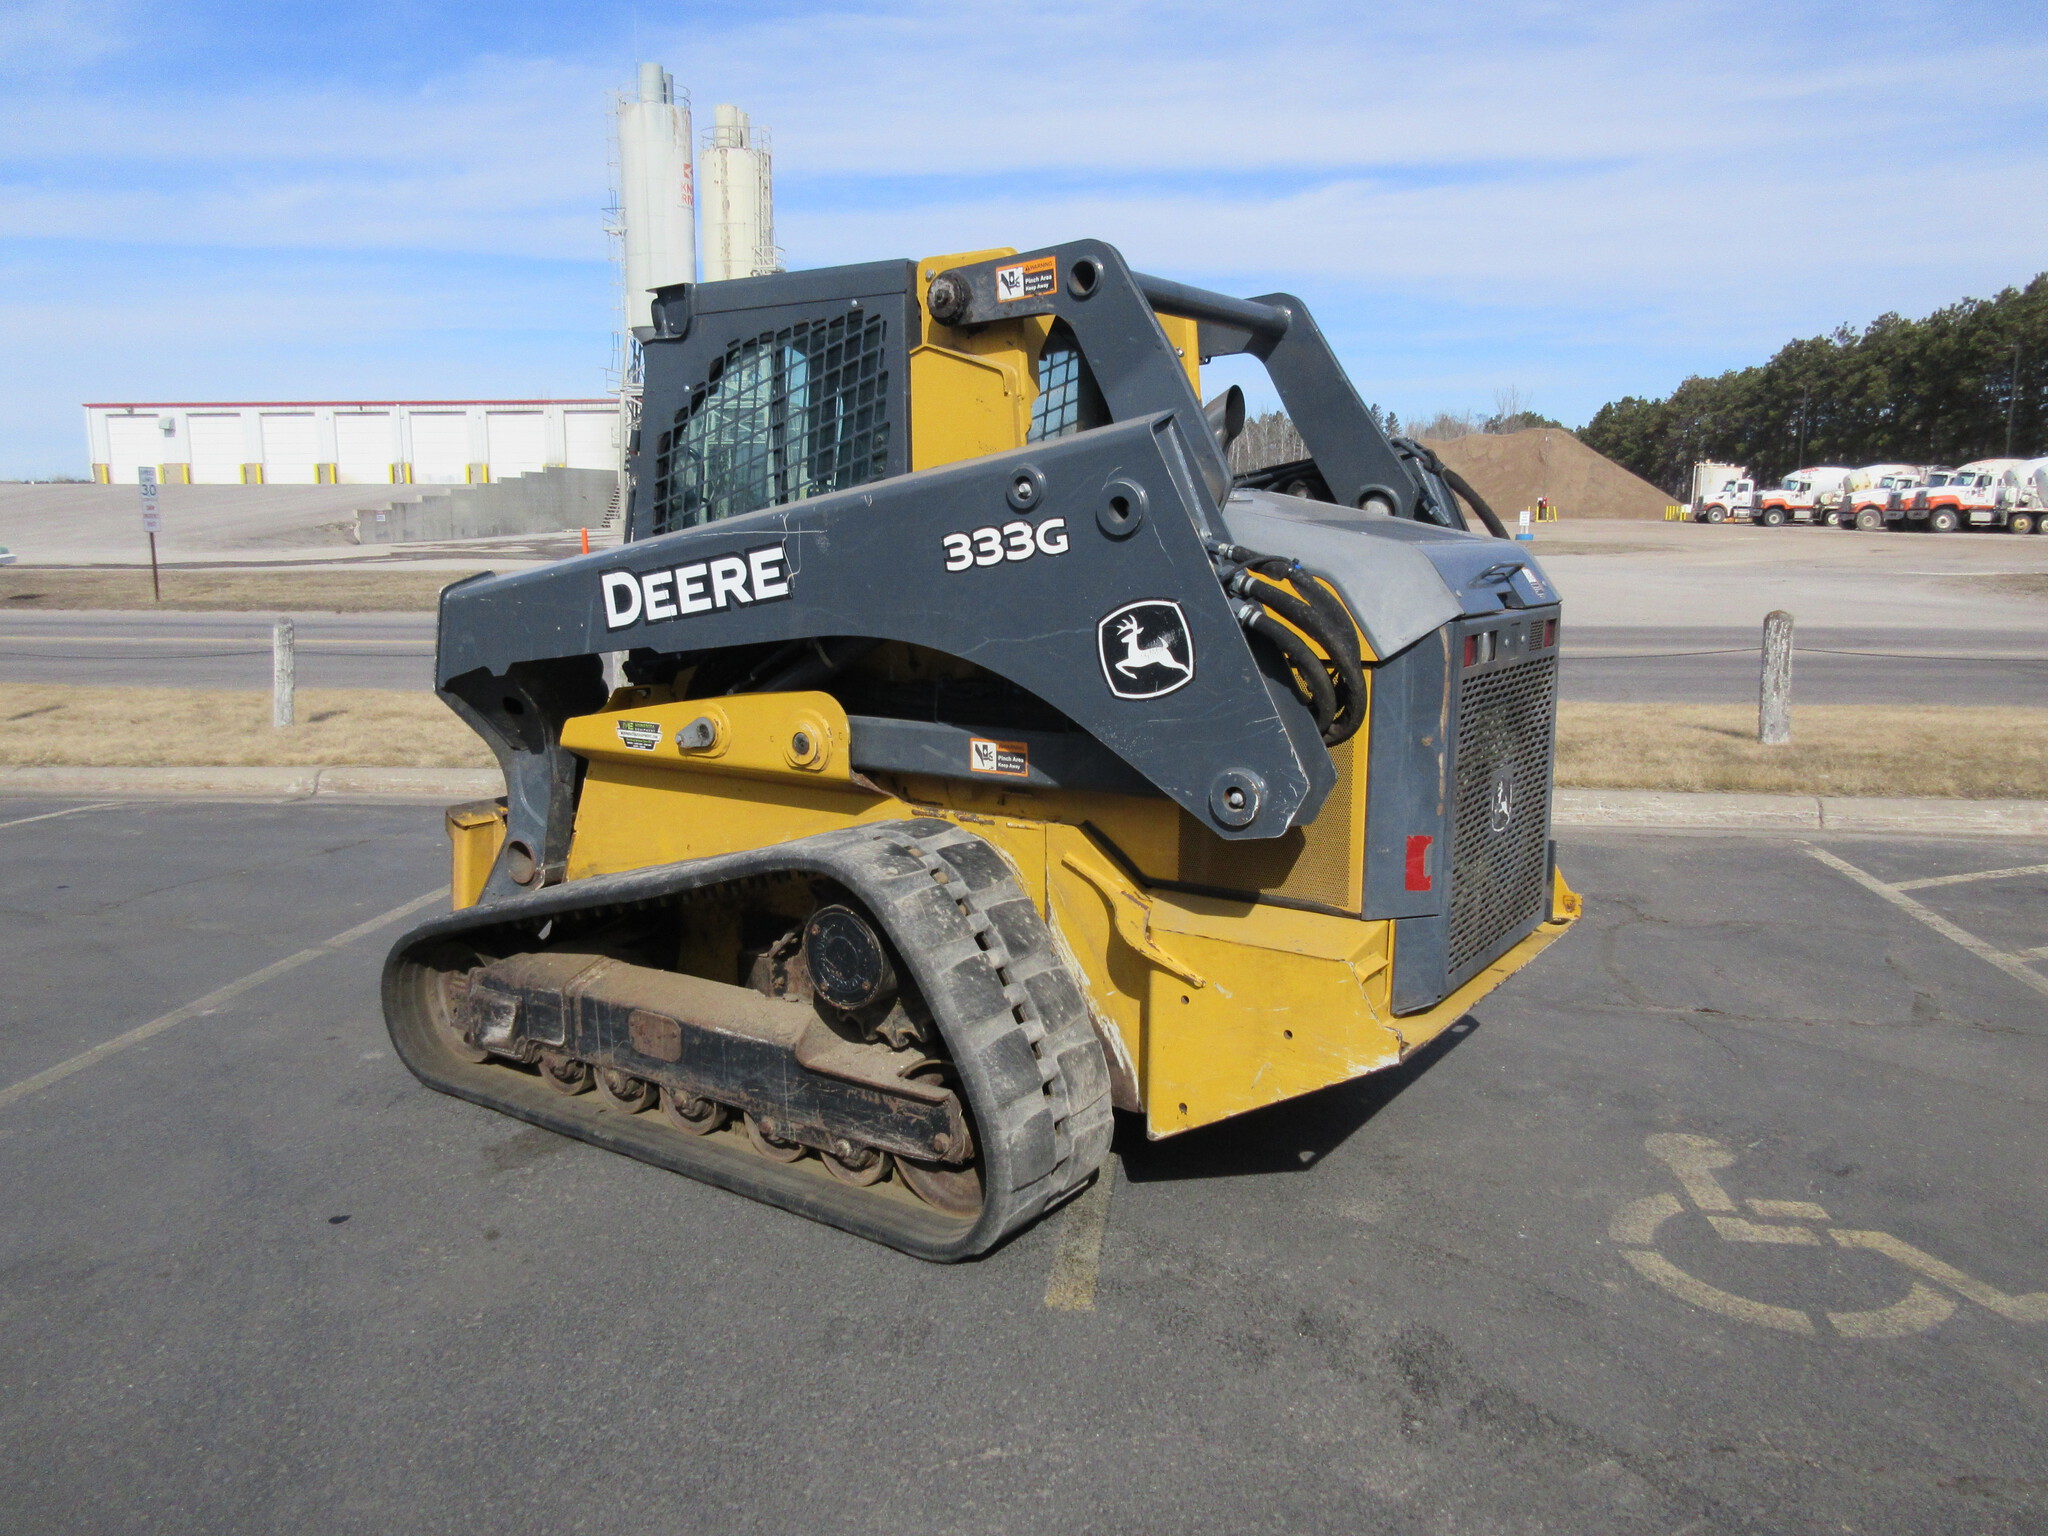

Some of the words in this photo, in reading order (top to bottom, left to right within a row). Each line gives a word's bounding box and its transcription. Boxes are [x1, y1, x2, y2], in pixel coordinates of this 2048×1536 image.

[1029, 261, 1053, 270] WARNING
[1024, 276, 1039, 285] Pinch
[1025, 284, 1037, 292] Keep
[141, 484, 157, 496] 30
[943, 518, 1069, 572] 333G
[601, 546, 789, 629] DEERE
